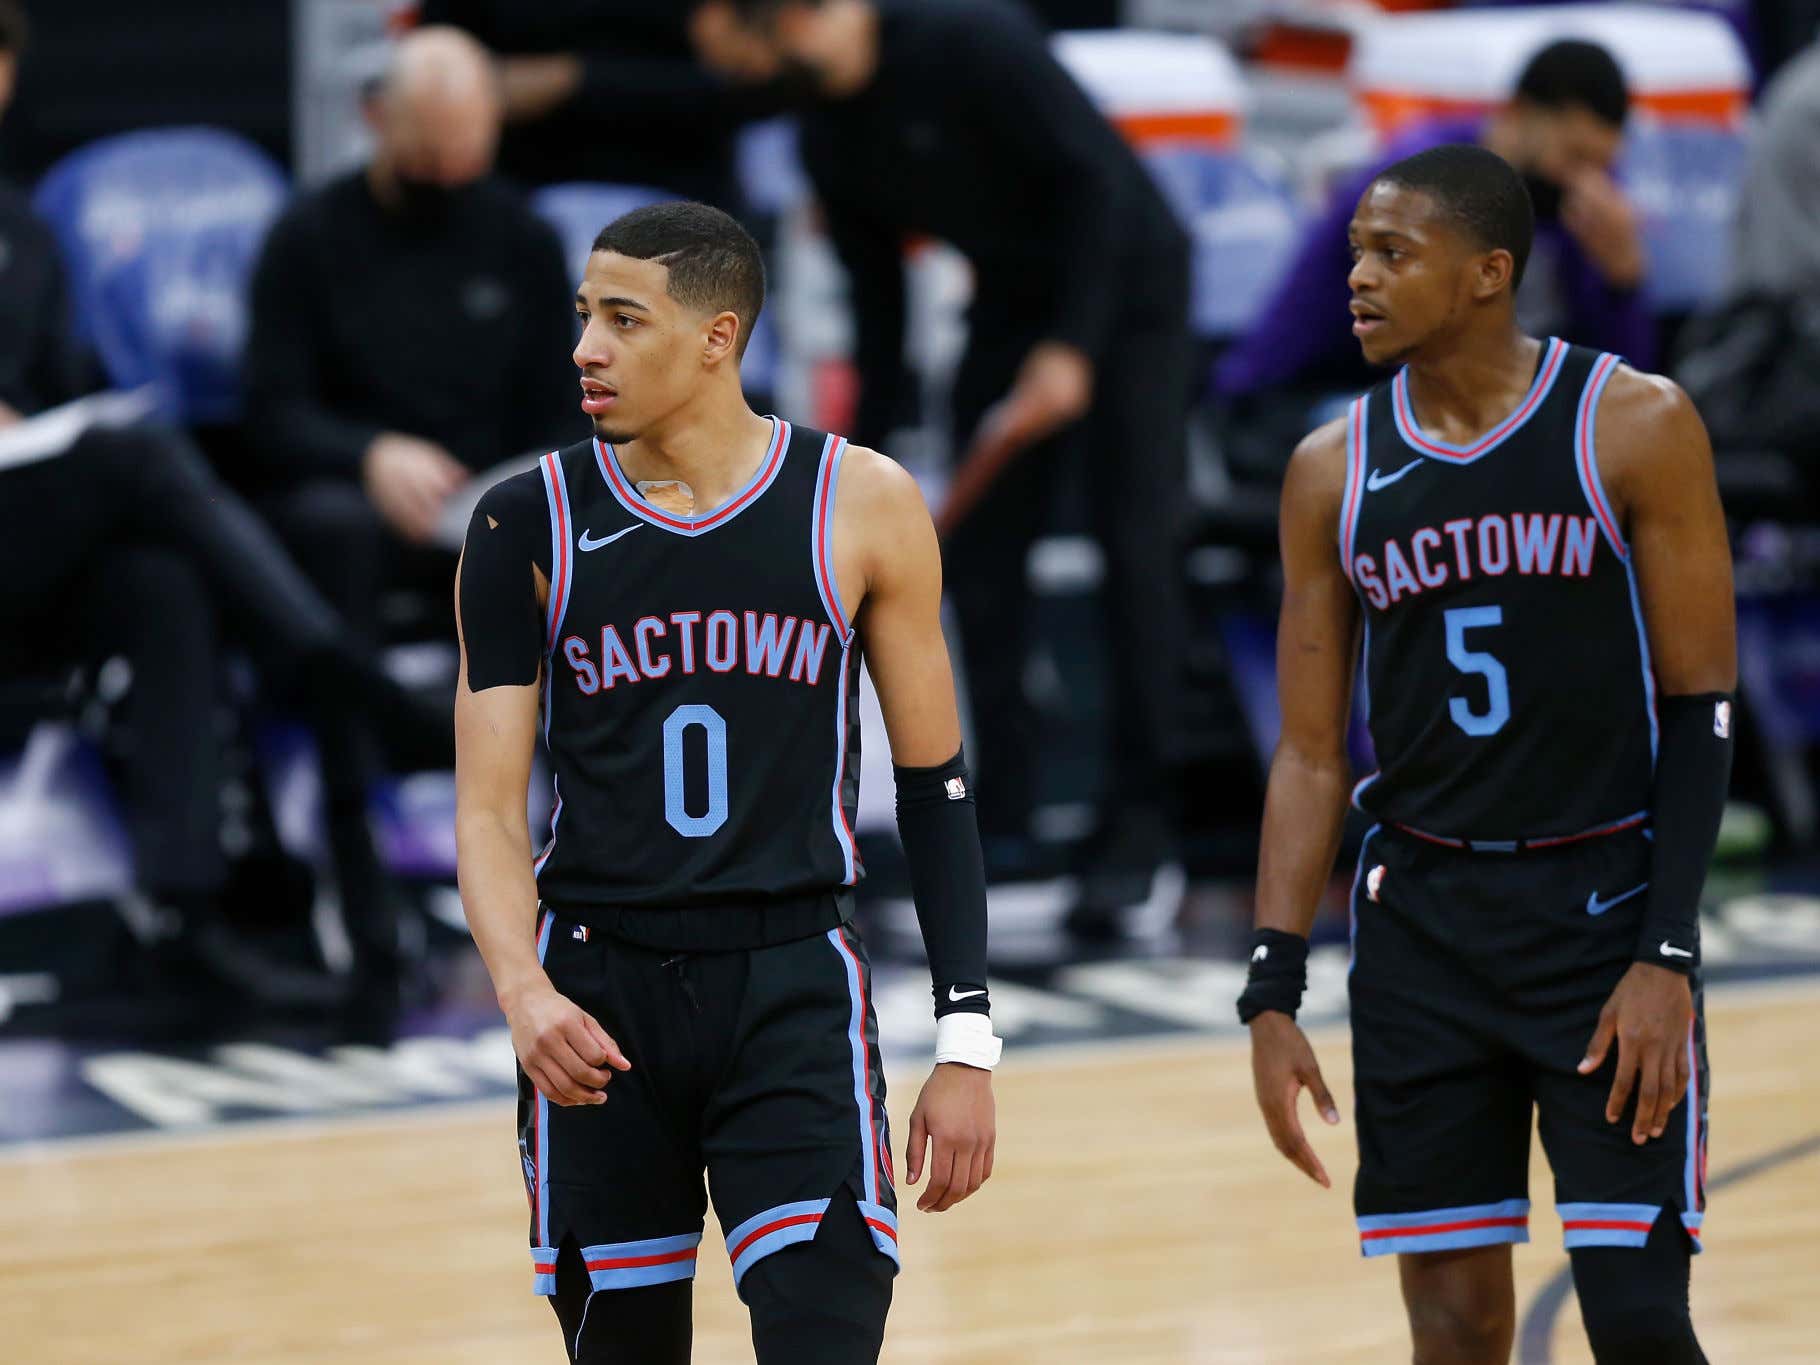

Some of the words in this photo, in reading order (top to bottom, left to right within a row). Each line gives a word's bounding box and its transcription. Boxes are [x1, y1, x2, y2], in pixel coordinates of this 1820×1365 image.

[1355, 513, 1597, 610] SACTOWN
[563, 610, 831, 695] SACTOWN
[1444, 605, 1511, 737] 5
[663, 704, 729, 838] 0
